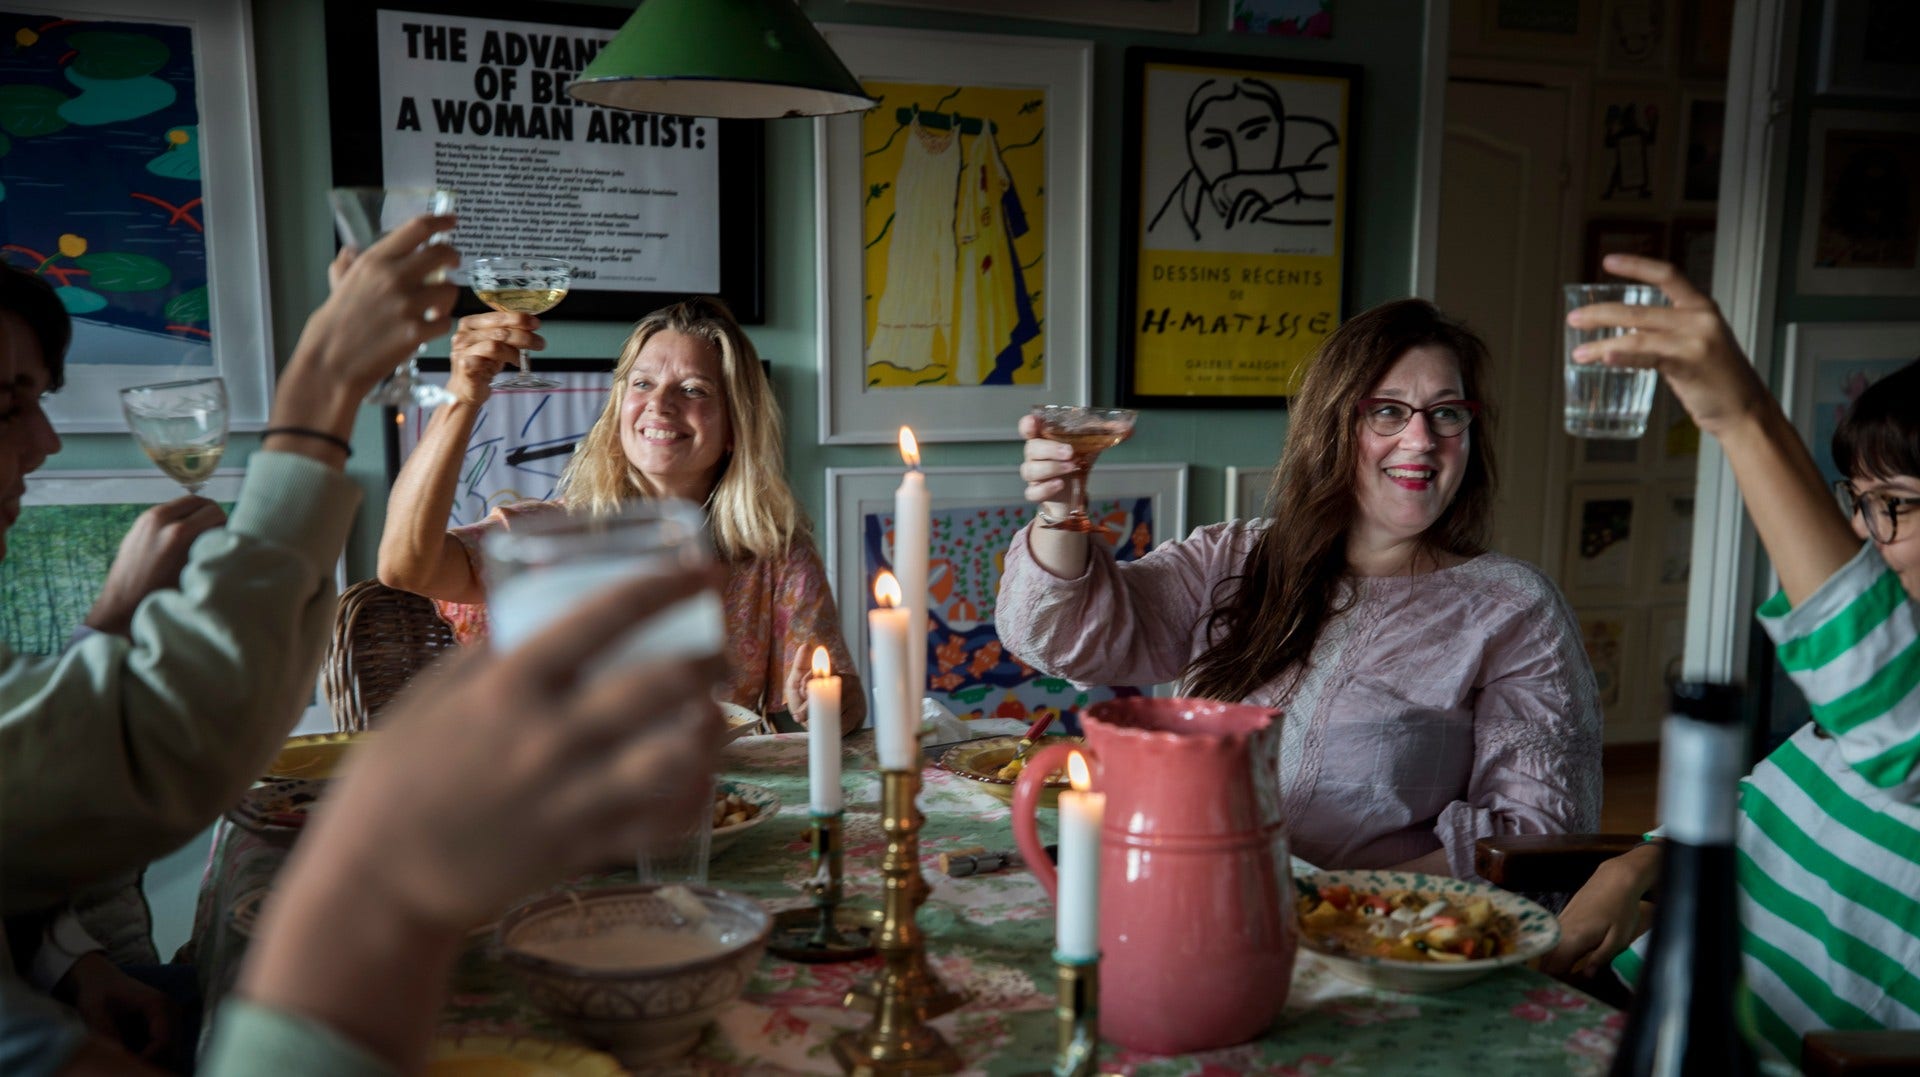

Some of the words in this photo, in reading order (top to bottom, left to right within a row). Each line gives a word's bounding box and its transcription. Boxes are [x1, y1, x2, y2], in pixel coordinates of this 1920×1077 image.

[402, 23, 467, 62] THE
[480, 30, 611, 71] ADVAN
[475, 66, 517, 101] OF
[396, 97, 421, 132] A
[433, 99, 574, 141] WOMAN
[586, 111, 706, 150] ARTIST:
[1153, 264, 1231, 283] DESSINS
[1242, 266, 1324, 286] RÉCENTS
[1229, 289, 1244, 300] DE
